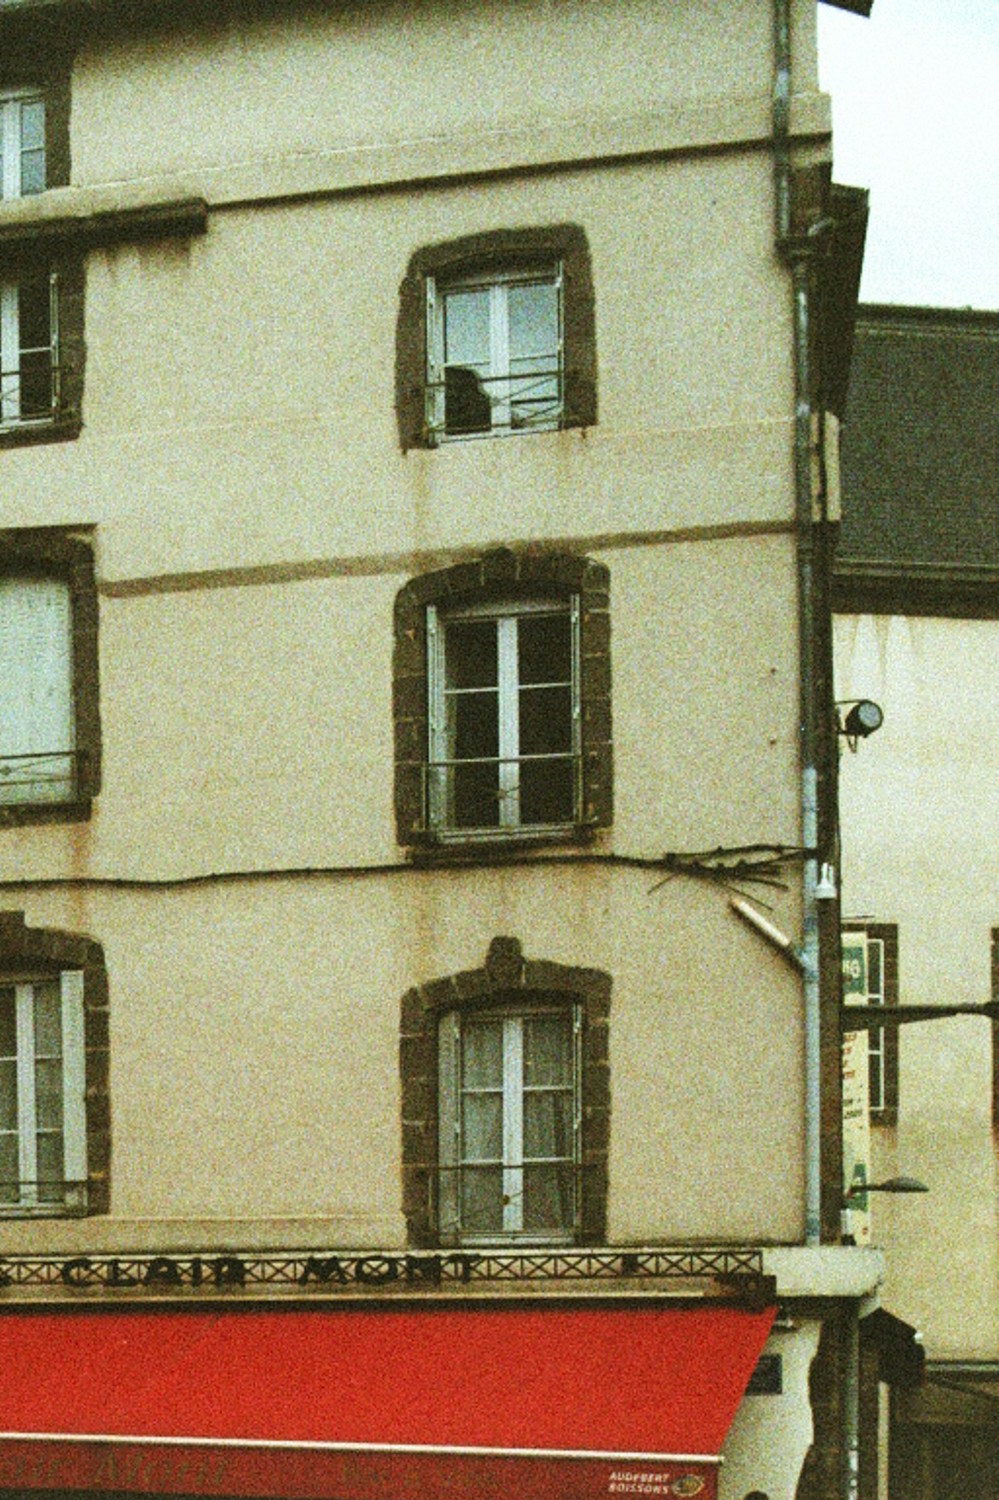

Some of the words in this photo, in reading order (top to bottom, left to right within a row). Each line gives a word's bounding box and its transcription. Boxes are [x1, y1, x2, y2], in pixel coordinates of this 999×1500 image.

[61, 1256, 248, 1290] CLAIR
[298, 1253, 485, 1288] MONT
[608, 1483, 669, 1494] BOISSONS
